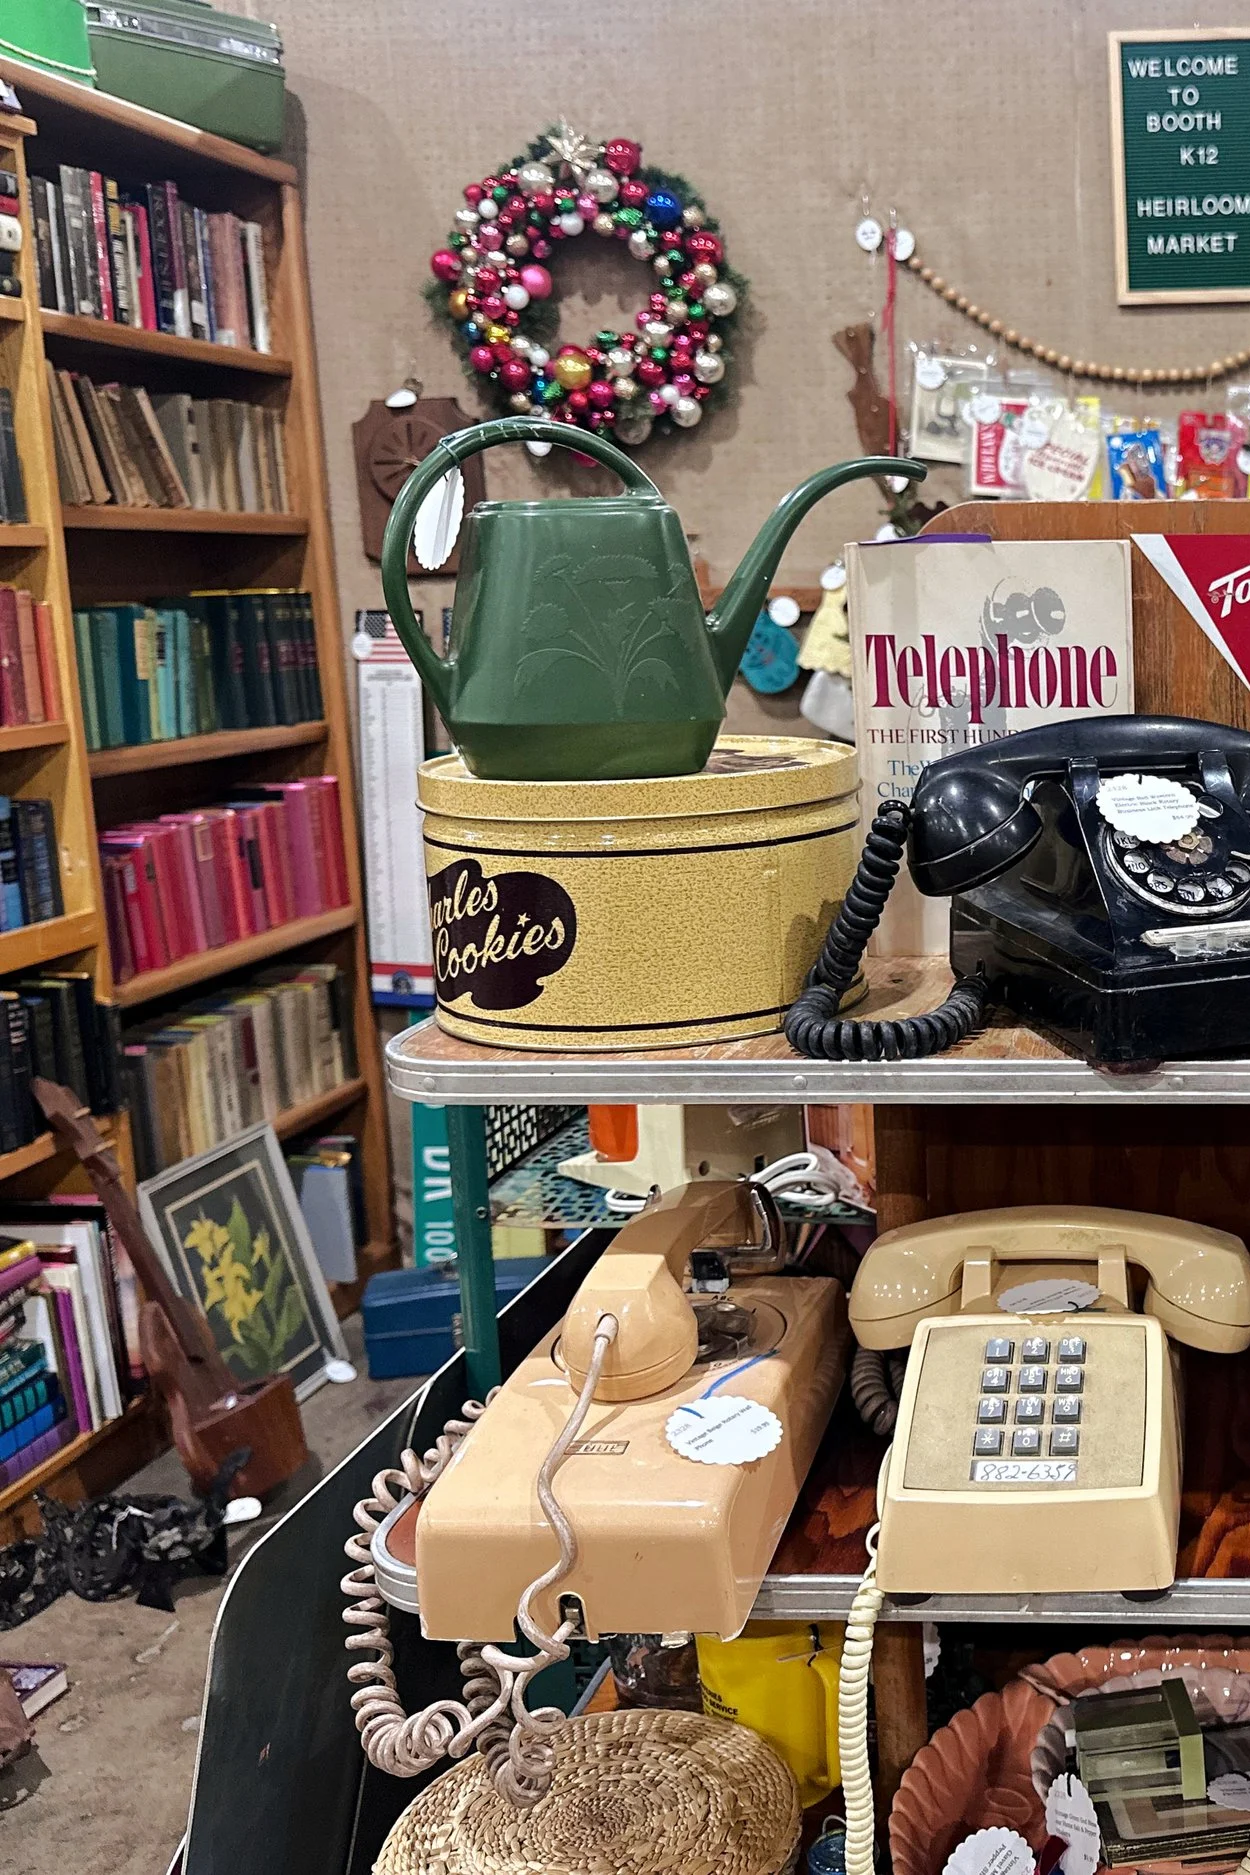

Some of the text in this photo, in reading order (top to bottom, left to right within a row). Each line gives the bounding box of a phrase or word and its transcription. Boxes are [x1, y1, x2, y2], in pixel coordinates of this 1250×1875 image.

[1127, 56, 1239, 78] WELCOME
[1167, 85, 1200, 106] TO
[1147, 111, 1221, 133] BOOTH
[1180, 146, 1218, 166] K12
[1147, 232, 1239, 255] MARKET
[865, 634, 1118, 724] Telephone
[867, 729, 906, 744] THE
[909, 729, 958, 744] FIRST
[887, 760, 920, 776] The
[435, 913, 565, 982] Cookies
[1065, 1375, 1073, 1384] 6
[1026, 1406, 1033, 1415] 8
